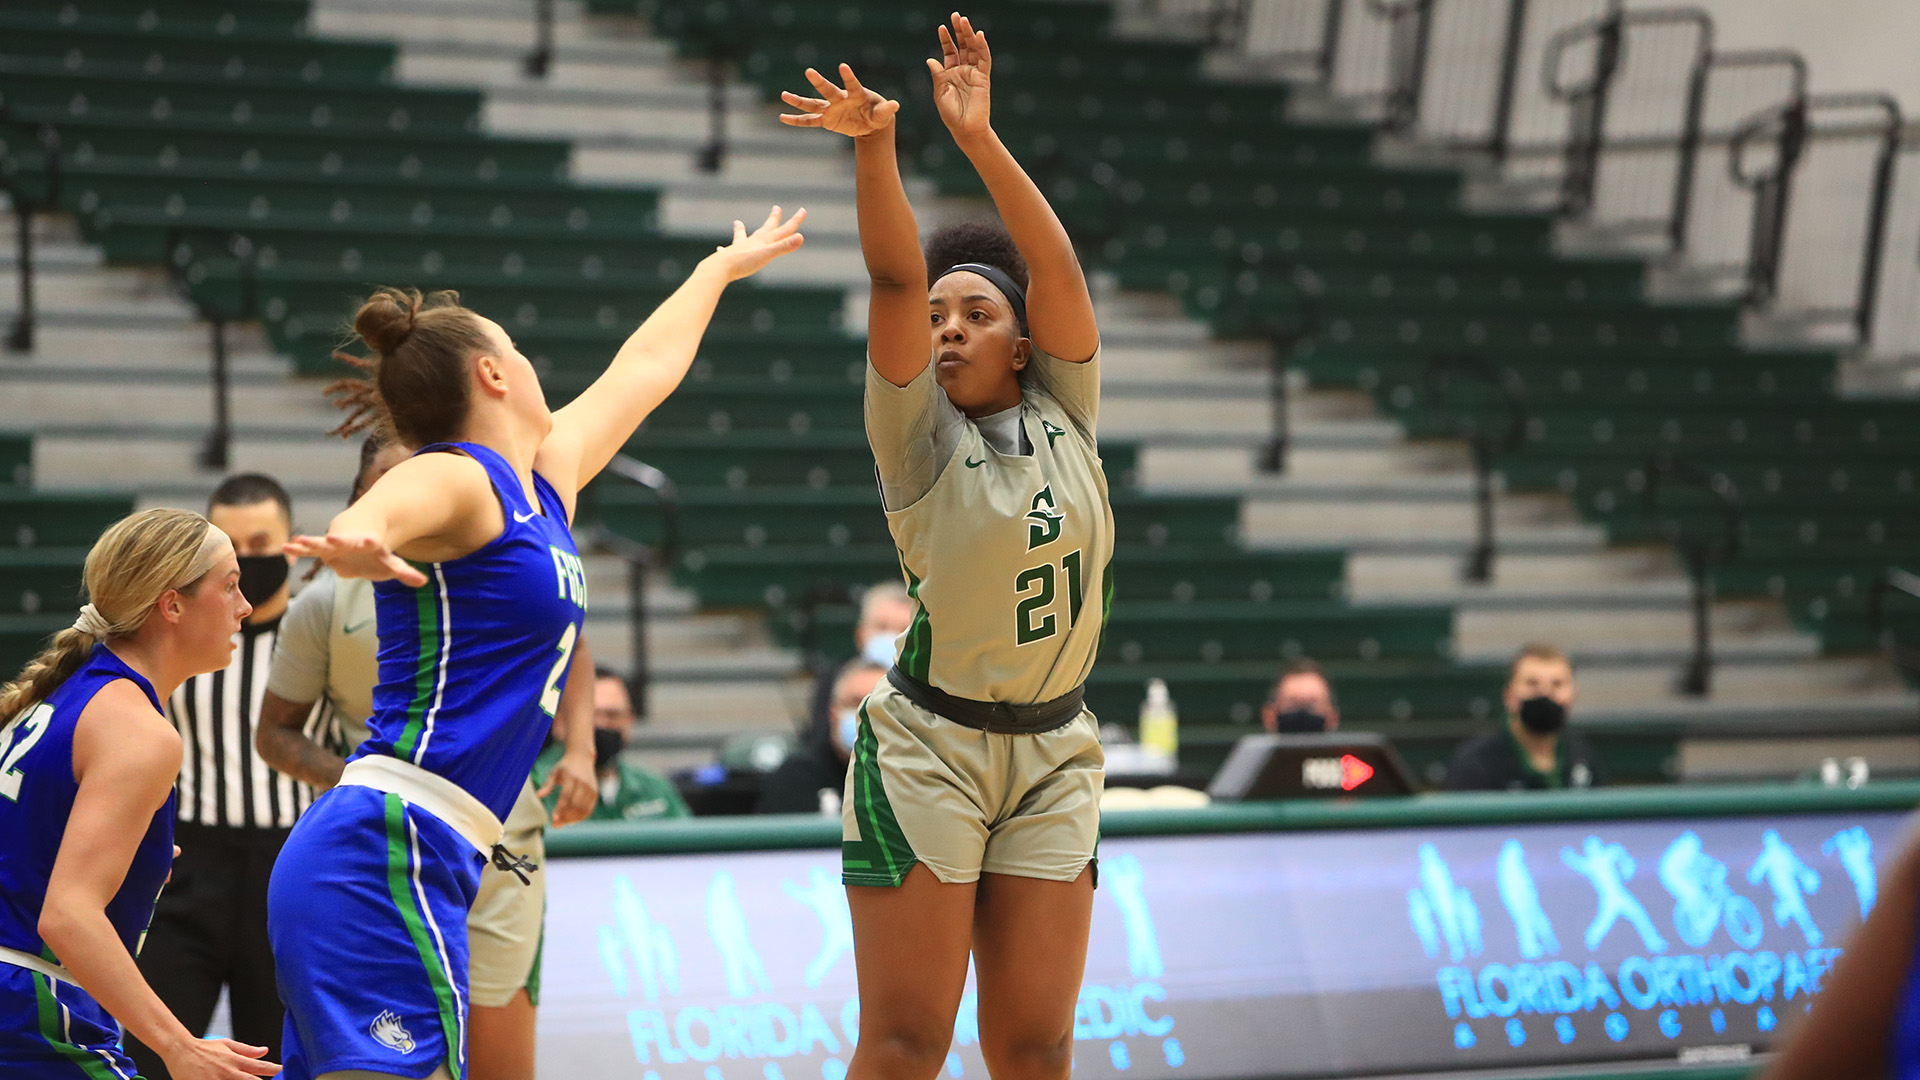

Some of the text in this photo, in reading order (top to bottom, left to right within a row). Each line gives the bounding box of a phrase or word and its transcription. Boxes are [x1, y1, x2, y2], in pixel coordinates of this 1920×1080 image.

[1015, 548, 1083, 647] 21
[1437, 960, 1618, 1020] FLORIDA
[627, 1001, 841, 1064] FLORIDA
